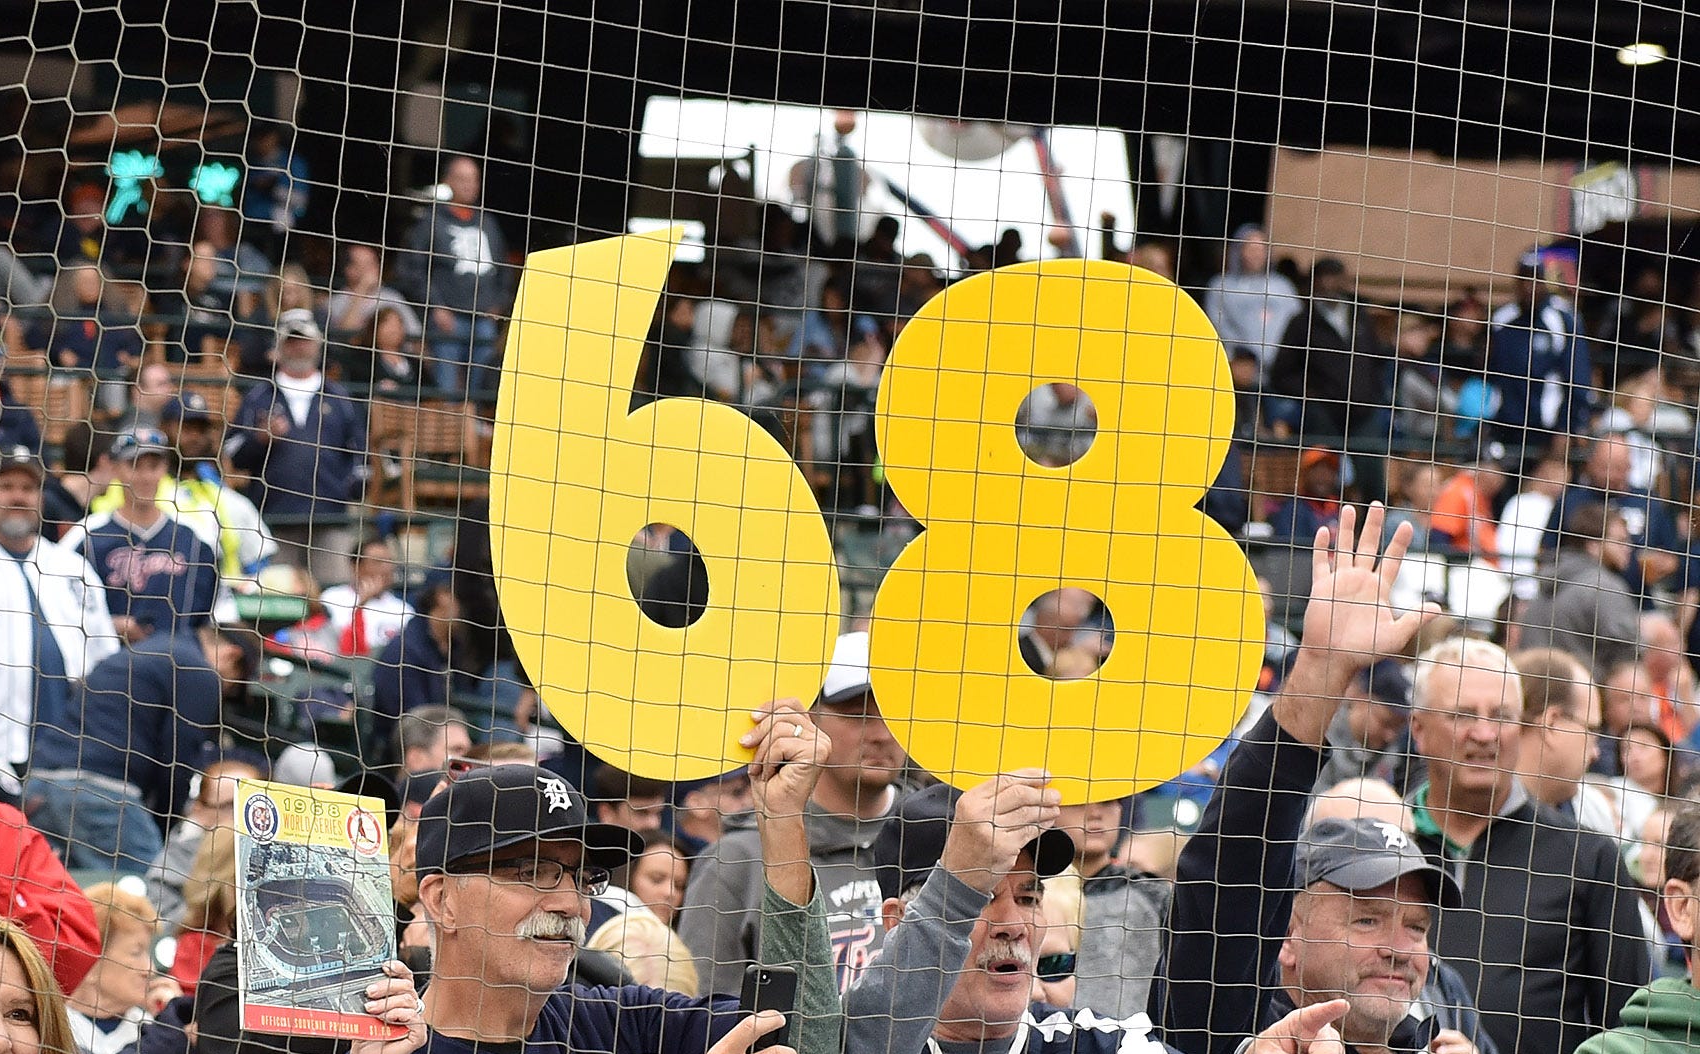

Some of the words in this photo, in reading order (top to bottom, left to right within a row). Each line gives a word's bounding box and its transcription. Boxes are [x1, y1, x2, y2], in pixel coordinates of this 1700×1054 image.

[489, 228, 841, 781] 6
[869, 259, 1266, 805] 8
[283, 797, 341, 818] 1968
[283, 813, 311, 832] WORLD
[313, 818, 344, 836] SERIES
[260, 1014, 291, 1028] OFFICIAL
[294, 1018, 327, 1031] SOUVENIR
[329, 1021, 360, 1033] PROGRAM
